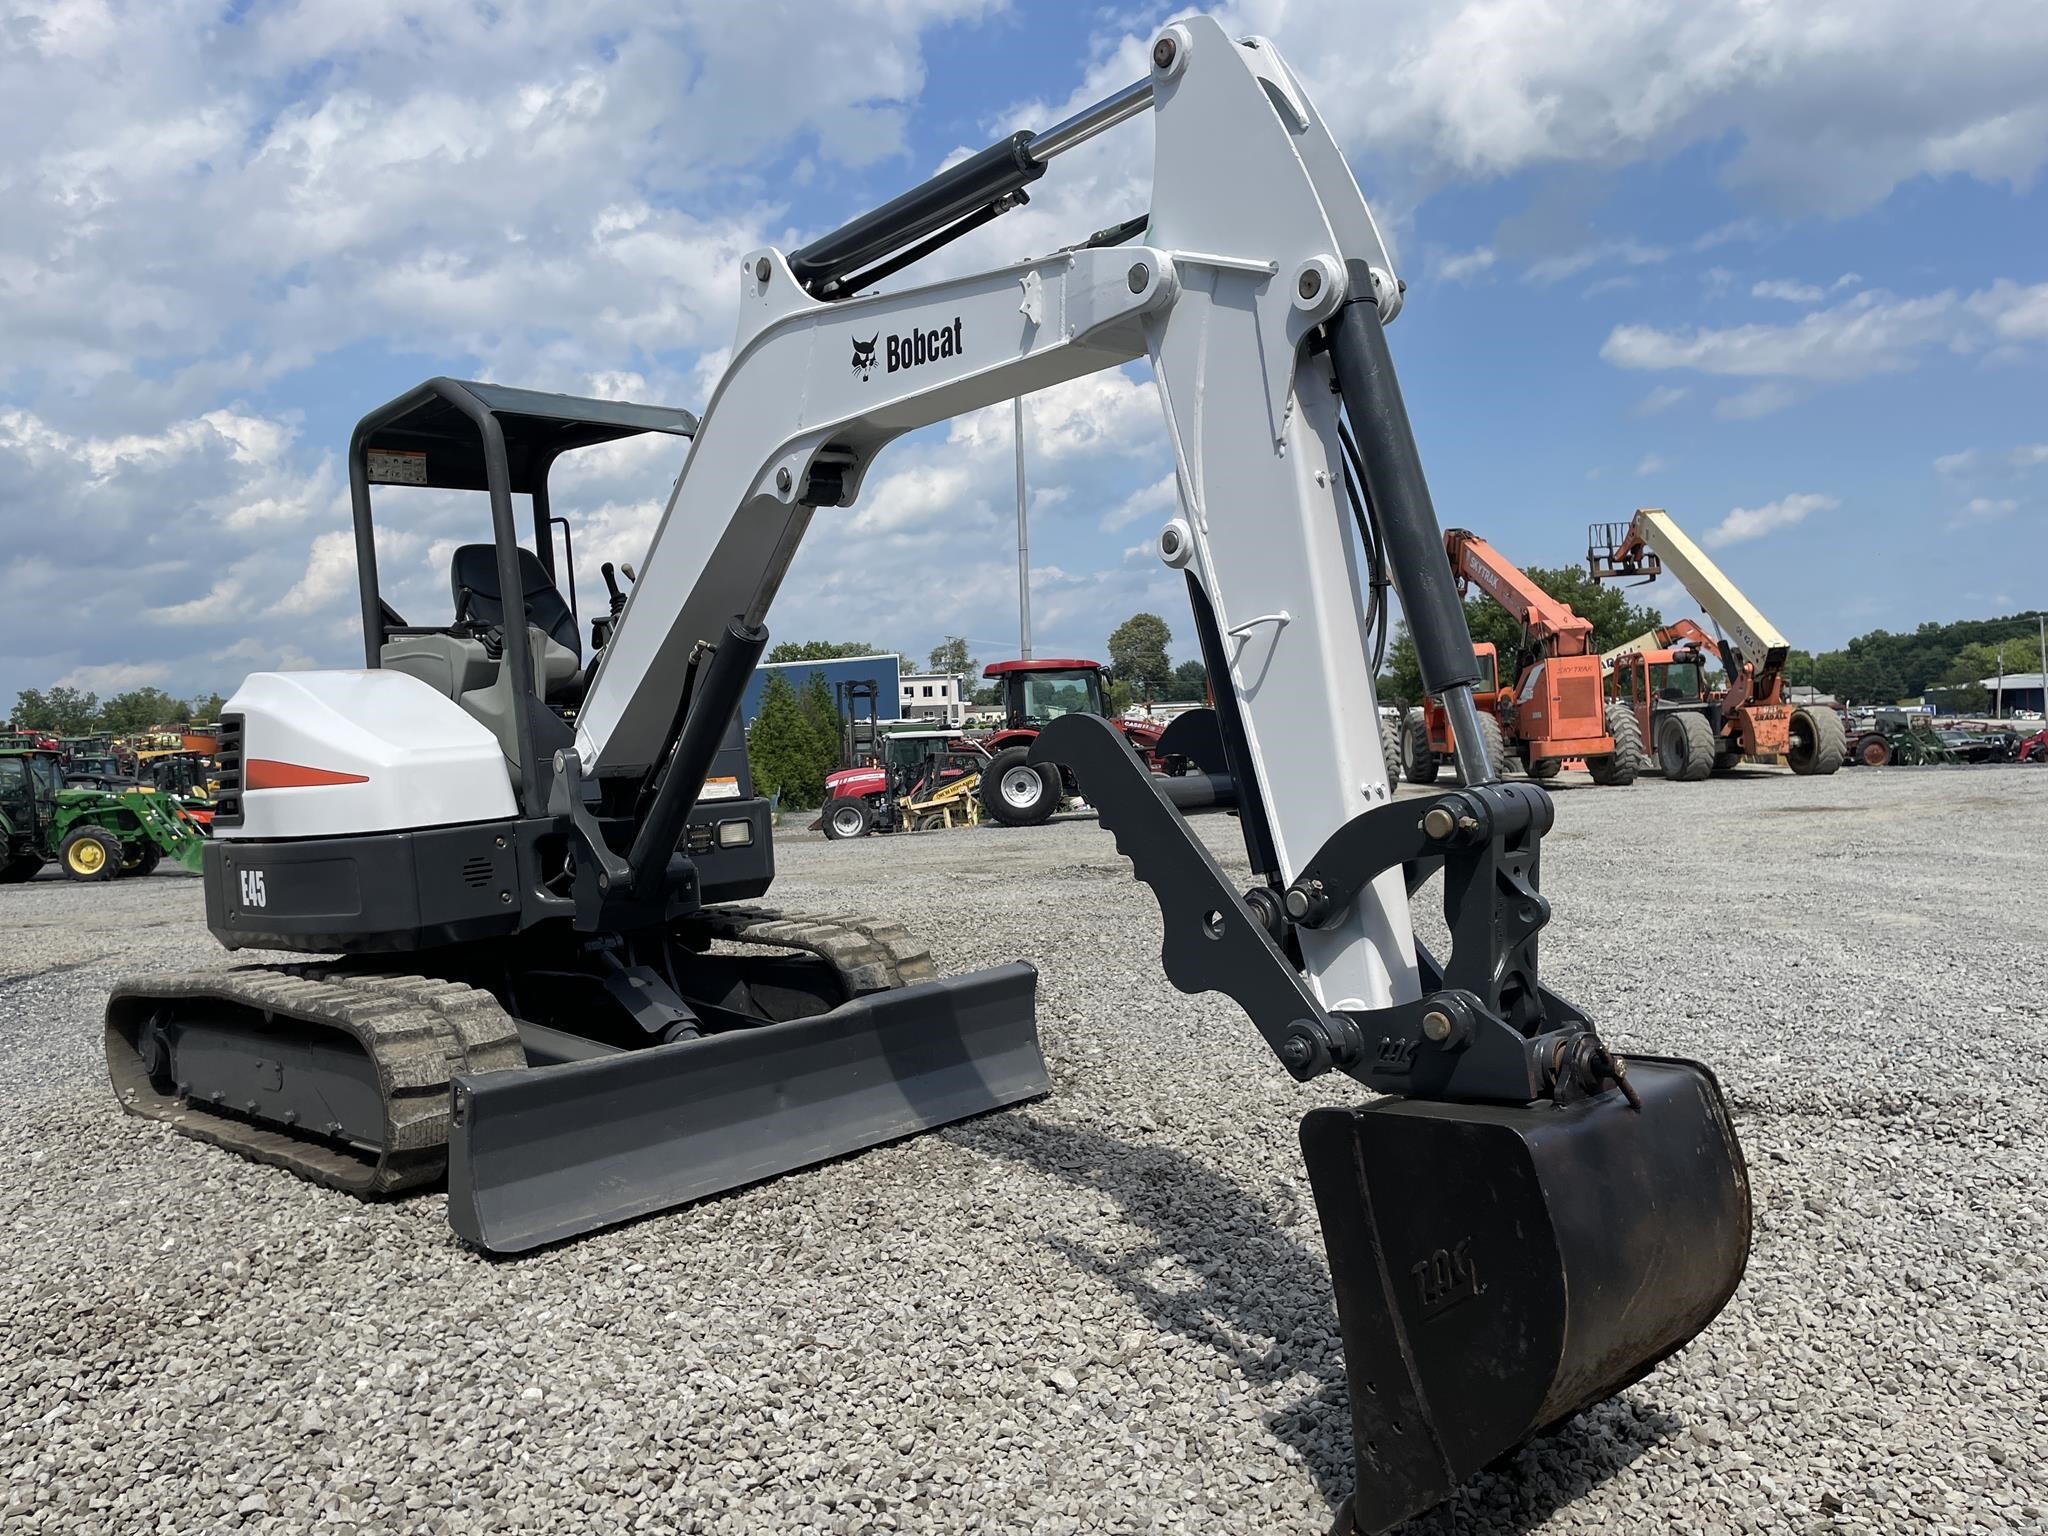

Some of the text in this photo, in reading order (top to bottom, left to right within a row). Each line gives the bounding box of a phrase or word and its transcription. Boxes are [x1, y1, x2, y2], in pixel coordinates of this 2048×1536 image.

[886, 316, 963, 373] Bobcat
[950, 778, 974, 792] HOLAND
[240, 870, 267, 908] E45
